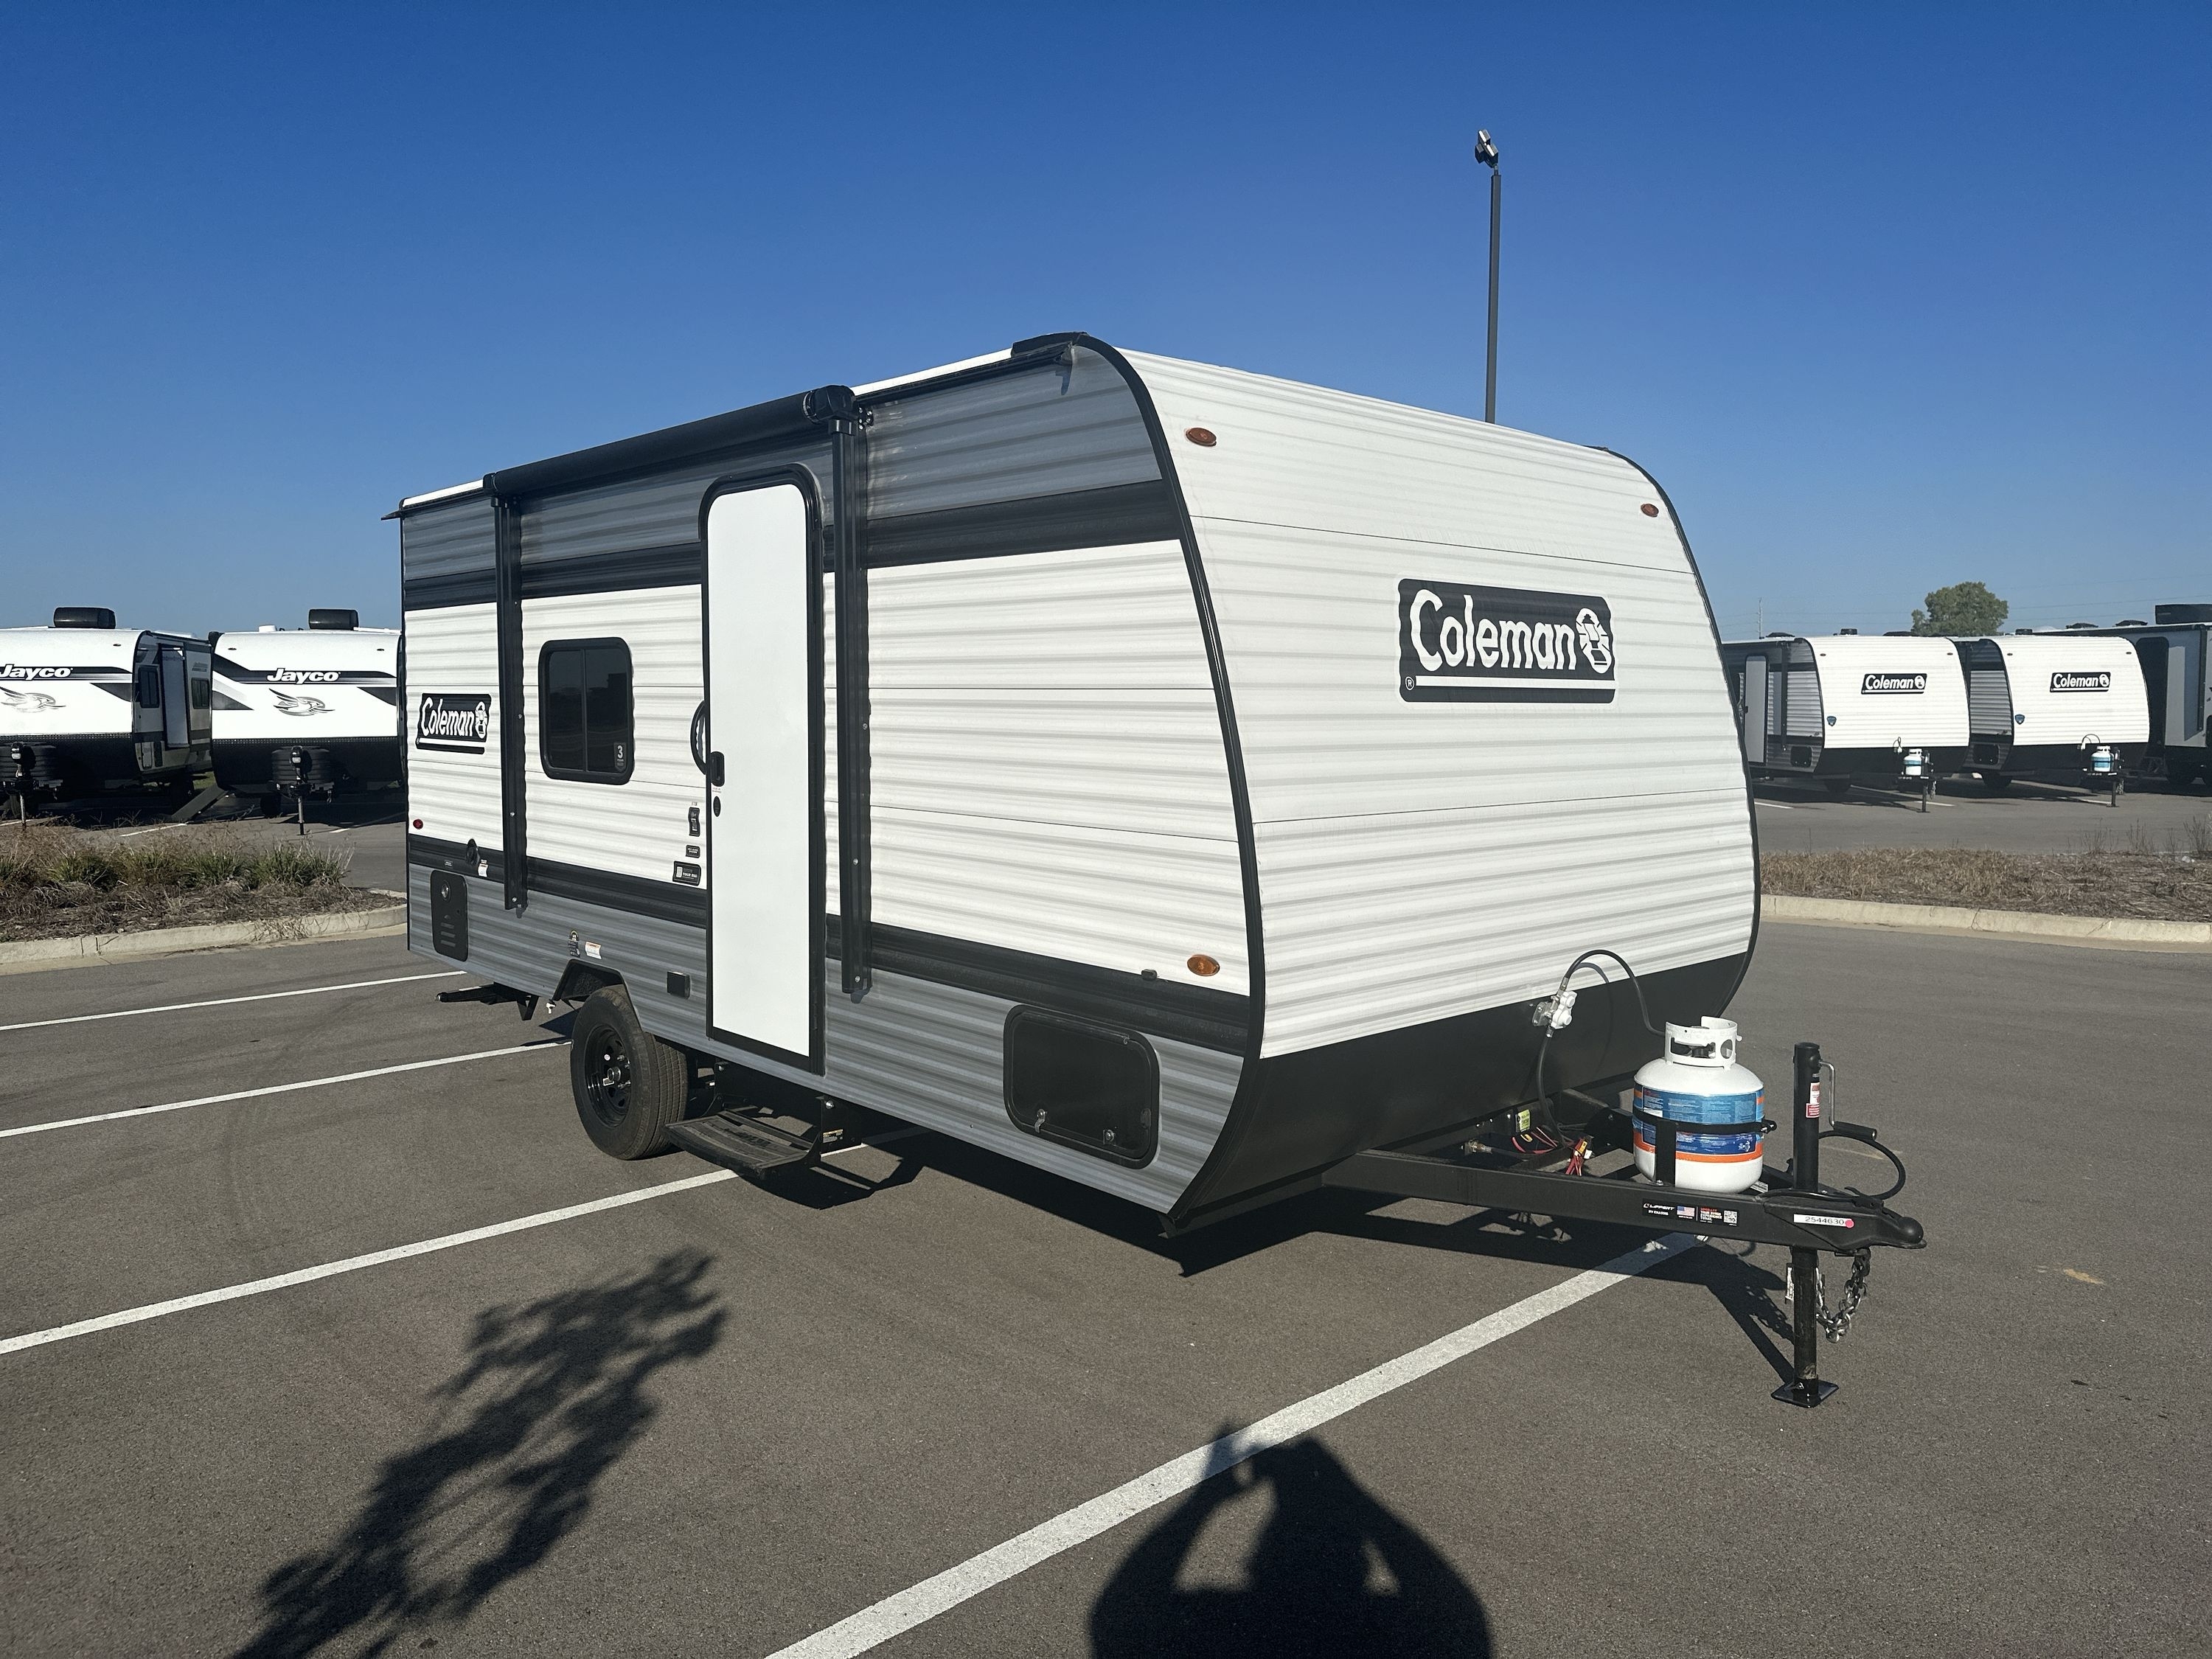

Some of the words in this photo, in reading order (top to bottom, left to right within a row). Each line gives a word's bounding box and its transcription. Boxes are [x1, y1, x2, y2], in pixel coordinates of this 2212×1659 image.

[1410, 588, 1576, 672] Coleman
[0, 664, 72, 681] Jayco
[267, 668, 339, 684] Jayco
[2053, 673, 2099, 688] Coleman
[1865, 674, 1914, 690] Coleman
[421, 697, 475, 737] Coleman
[617, 745, 623, 759] 3
[1805, 1217, 1845, 1225] 2544630
